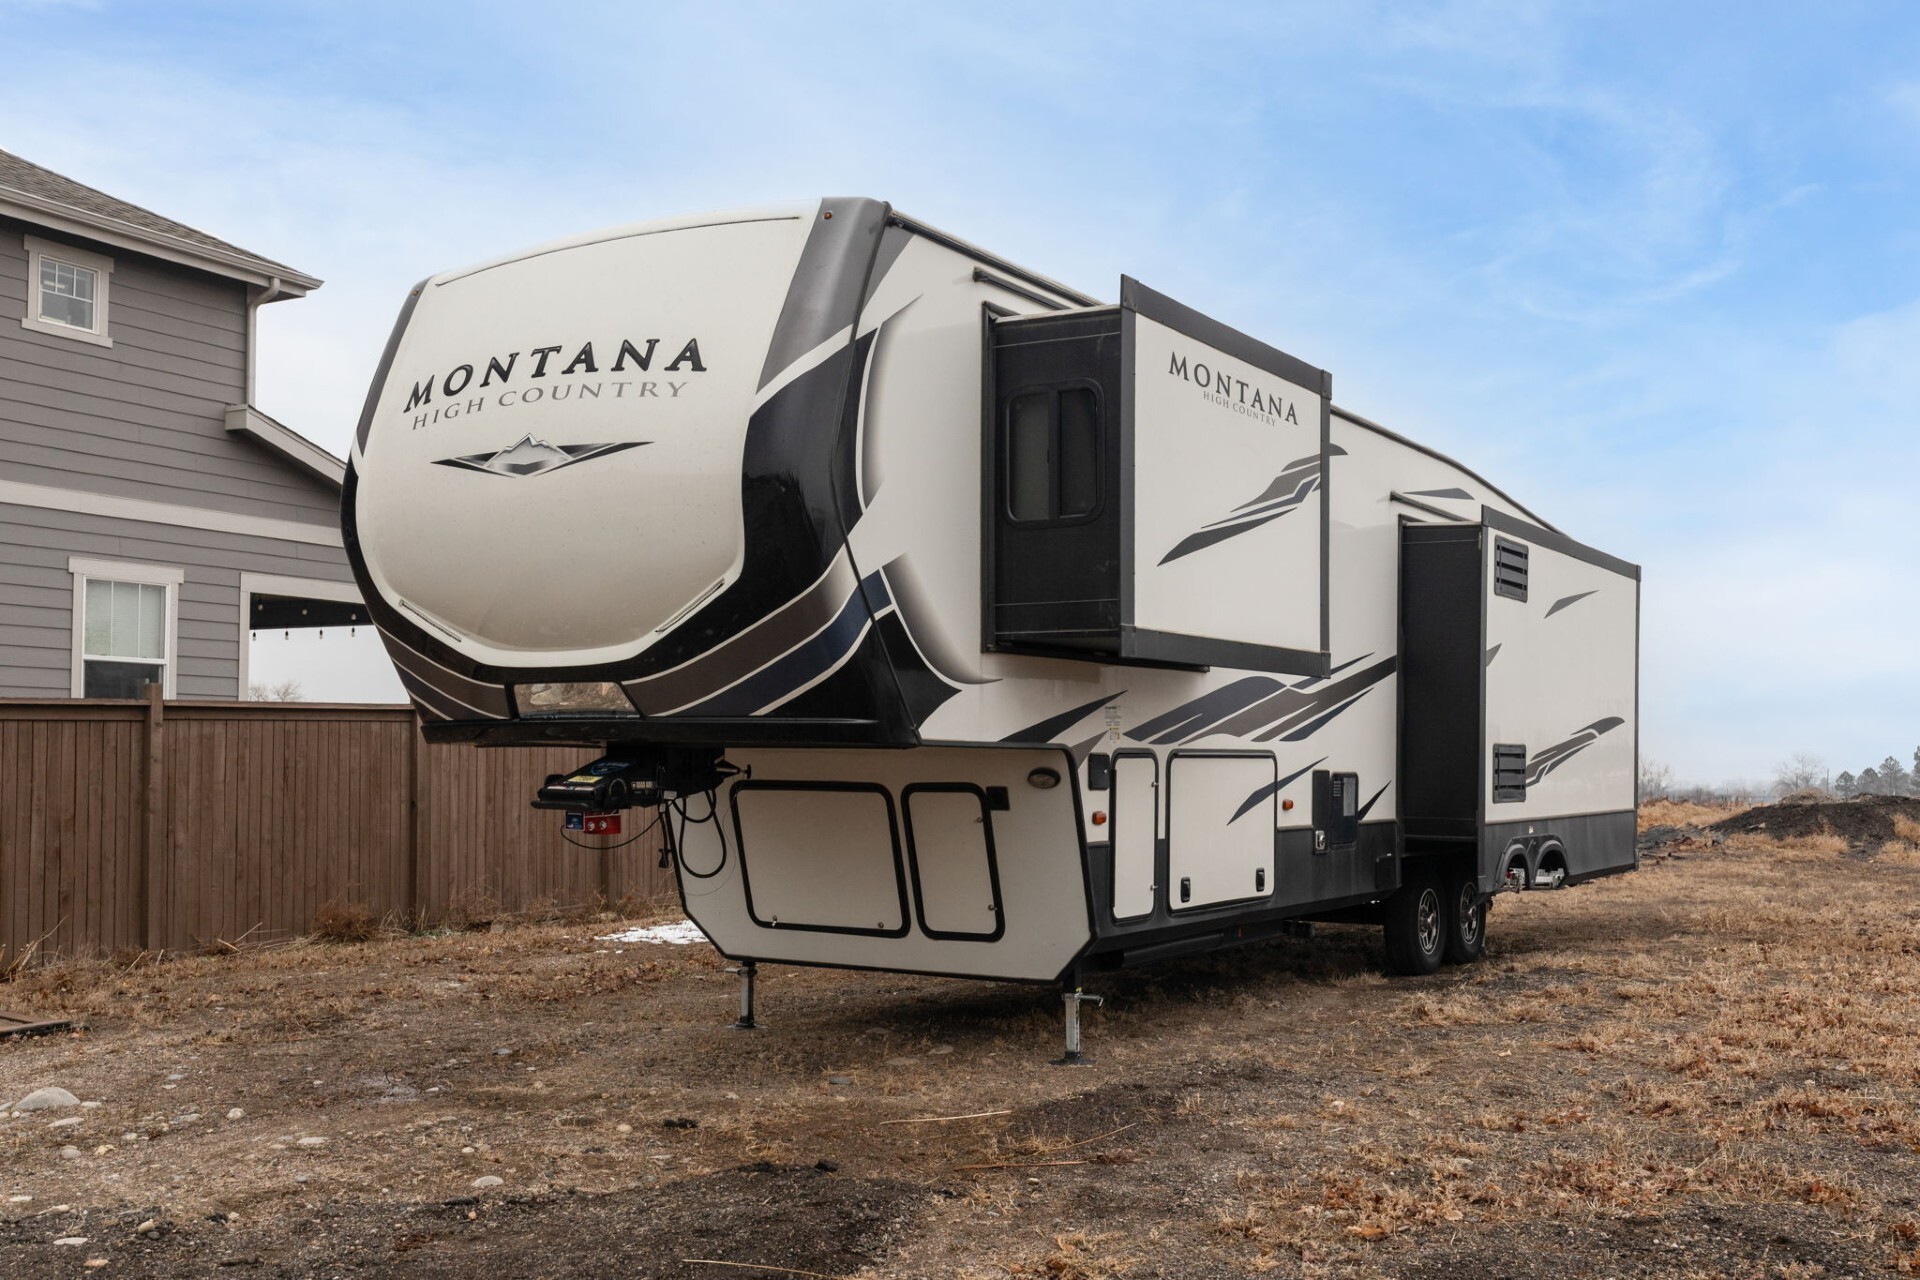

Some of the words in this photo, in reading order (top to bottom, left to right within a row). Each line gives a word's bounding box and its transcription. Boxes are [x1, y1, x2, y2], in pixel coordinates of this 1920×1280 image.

[403, 338, 707, 413] MONTANA
[412, 397, 485, 430] HIGH
[497, 381, 688, 407] COUNTRY
[1168, 351, 1298, 426] MONTANA
[1203, 391, 1229, 409] HIGH
[1232, 403, 1276, 427] COUNTRY
